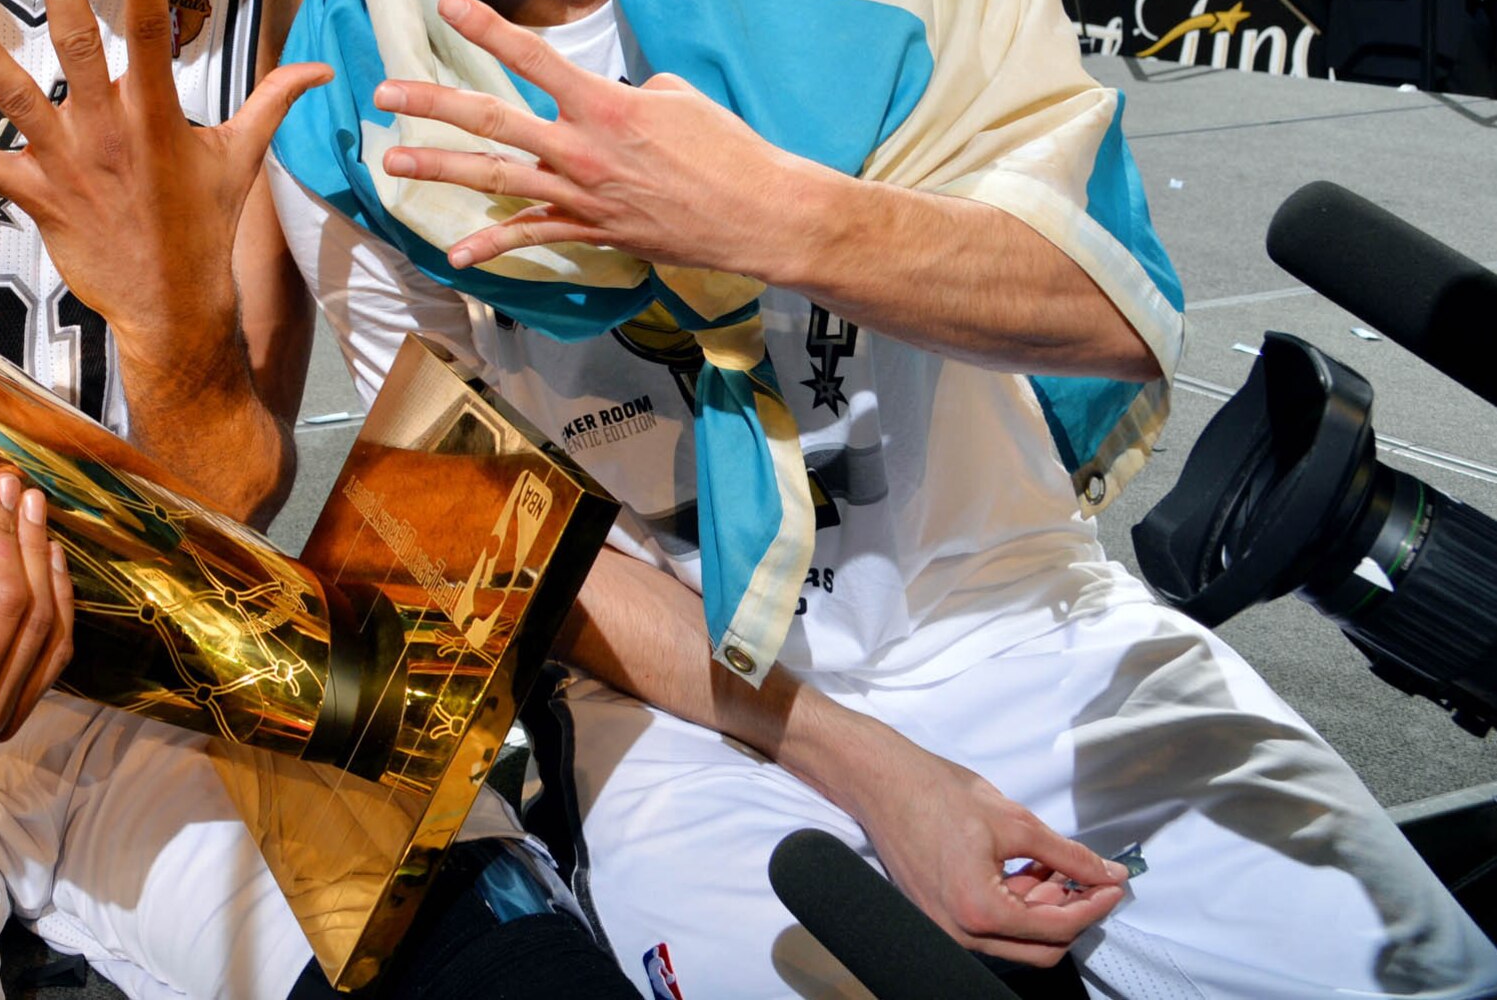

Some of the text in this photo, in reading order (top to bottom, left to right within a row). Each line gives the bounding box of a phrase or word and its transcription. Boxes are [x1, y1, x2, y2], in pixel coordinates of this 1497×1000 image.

[562, 395, 654, 442] KER ROOM
[603, 412, 658, 444] EDITION
[522, 485, 547, 521] NBA
